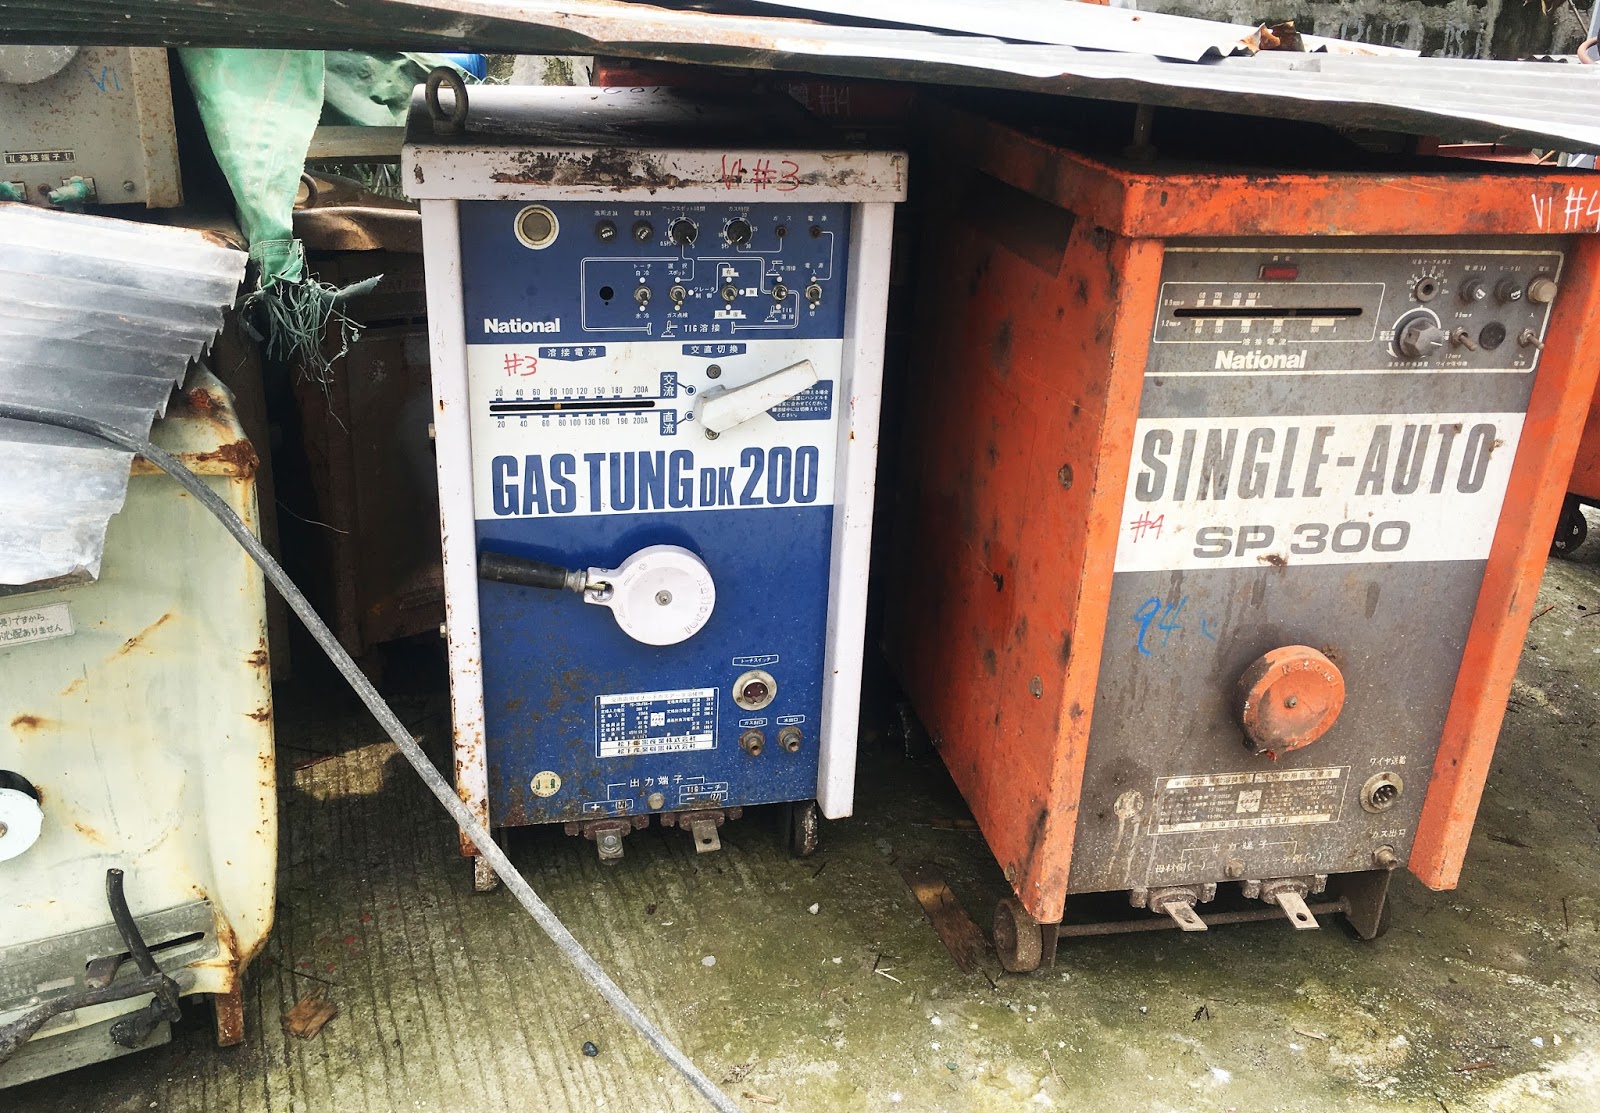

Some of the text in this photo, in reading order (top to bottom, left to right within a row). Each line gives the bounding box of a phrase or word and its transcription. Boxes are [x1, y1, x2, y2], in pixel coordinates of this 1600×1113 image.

[751, 158, 800, 192] #3
[1564, 187, 1600, 233] #4
[483, 318, 560, 333] National
[547, 347, 598, 357] 溶接電流
[690, 344, 740, 355] 交直切換
[1214, 350, 1308, 370] National
[503, 353, 538, 377] #3
[532, 388, 541, 396] 60
[662, 374, 675, 397] 交流
[519, 420, 528, 428] 40
[569, 419, 581, 427] 100
[617, 417, 628, 425] 190
[633, 417, 648, 425] 200A
[662, 411, 675, 434] 直流
[1135, 423, 1497, 502] SINGLE-AUTO
[1130, 510, 1165, 543] #4
[1193, 520, 1411, 559] SP 300
[629, 774, 684, 788] 出力端子
